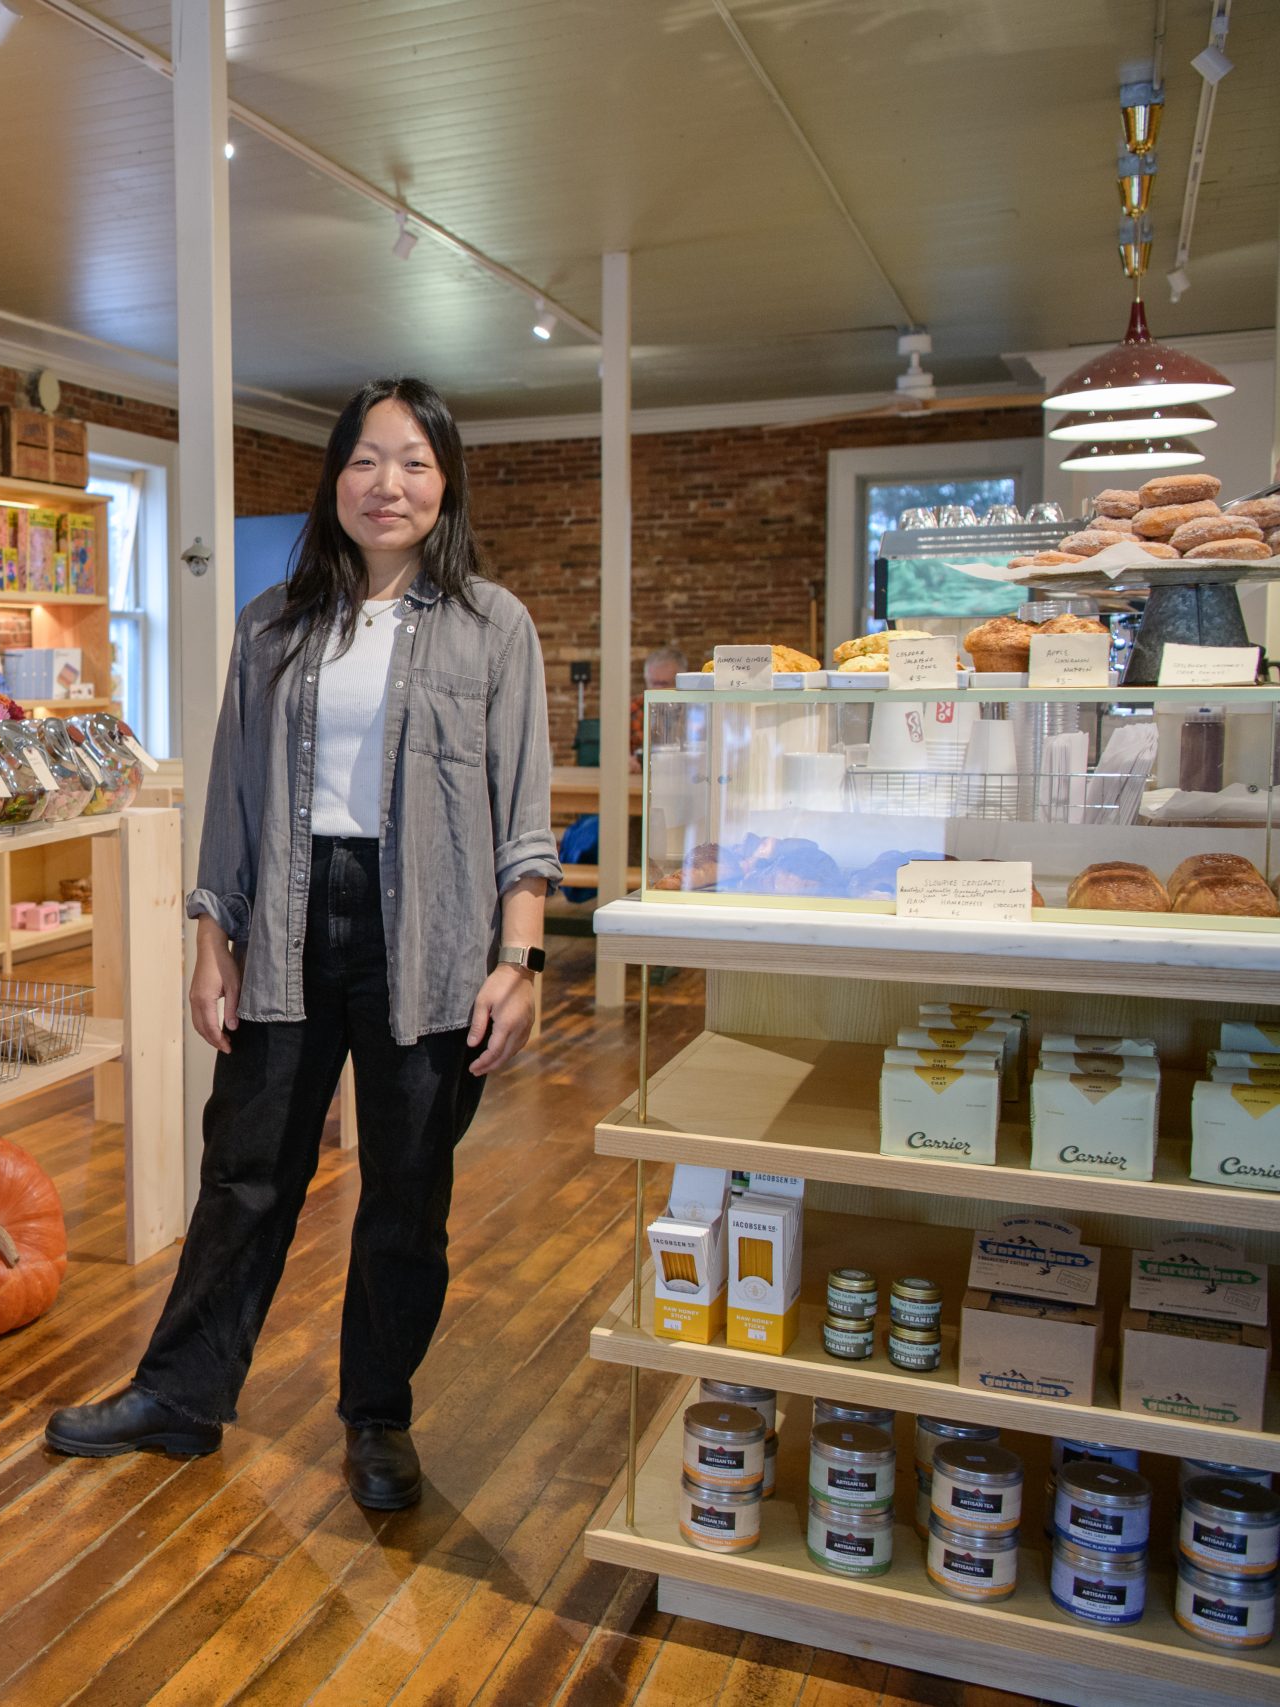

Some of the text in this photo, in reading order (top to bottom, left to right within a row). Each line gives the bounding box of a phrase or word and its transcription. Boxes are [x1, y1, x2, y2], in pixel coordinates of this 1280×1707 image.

[907, 1131, 972, 1155] Carrier
[1059, 1144, 1128, 1170] Carrier
[1220, 1156, 1280, 1178] Carrie
[754, 1173, 788, 1184] JACOBSEN
[732, 1220, 766, 1231] JACOBSEN
[653, 1238, 686, 1248] JACOBSEN
[671, 1312, 692, 1321] STICKS
[678, 1308, 700, 1316] HONEY
[736, 1314, 774, 1326] RAW HONEY
[900, 1314, 934, 1324] CARAMEL
[744, 1322, 766, 1330] STICKS
[825, 1340, 856, 1353] CARAMEL
[893, 1352, 926, 1365] CARAMEL
[706, 1456, 727, 1464] ARTISAN
[836, 1479, 859, 1487] ARTISAN
[960, 1499, 983, 1508] ARTISAN
[697, 1515, 718, 1524] ARTISAN
[1078, 1517, 1114, 1531] ARTISAN TEA
[834, 1542, 856, 1551] ARTISAN
[1072, 1537, 1092, 1549] ORGANIC
[1200, 1535, 1237, 1550] ARTISAN TEA
[951, 1561, 974, 1571] ARTISAN
[1082, 1589, 1106, 1600] ARTISAN
[1075, 1608, 1096, 1619] ORGANIC
[1201, 1607, 1238, 1622] ARTISAN TEA
